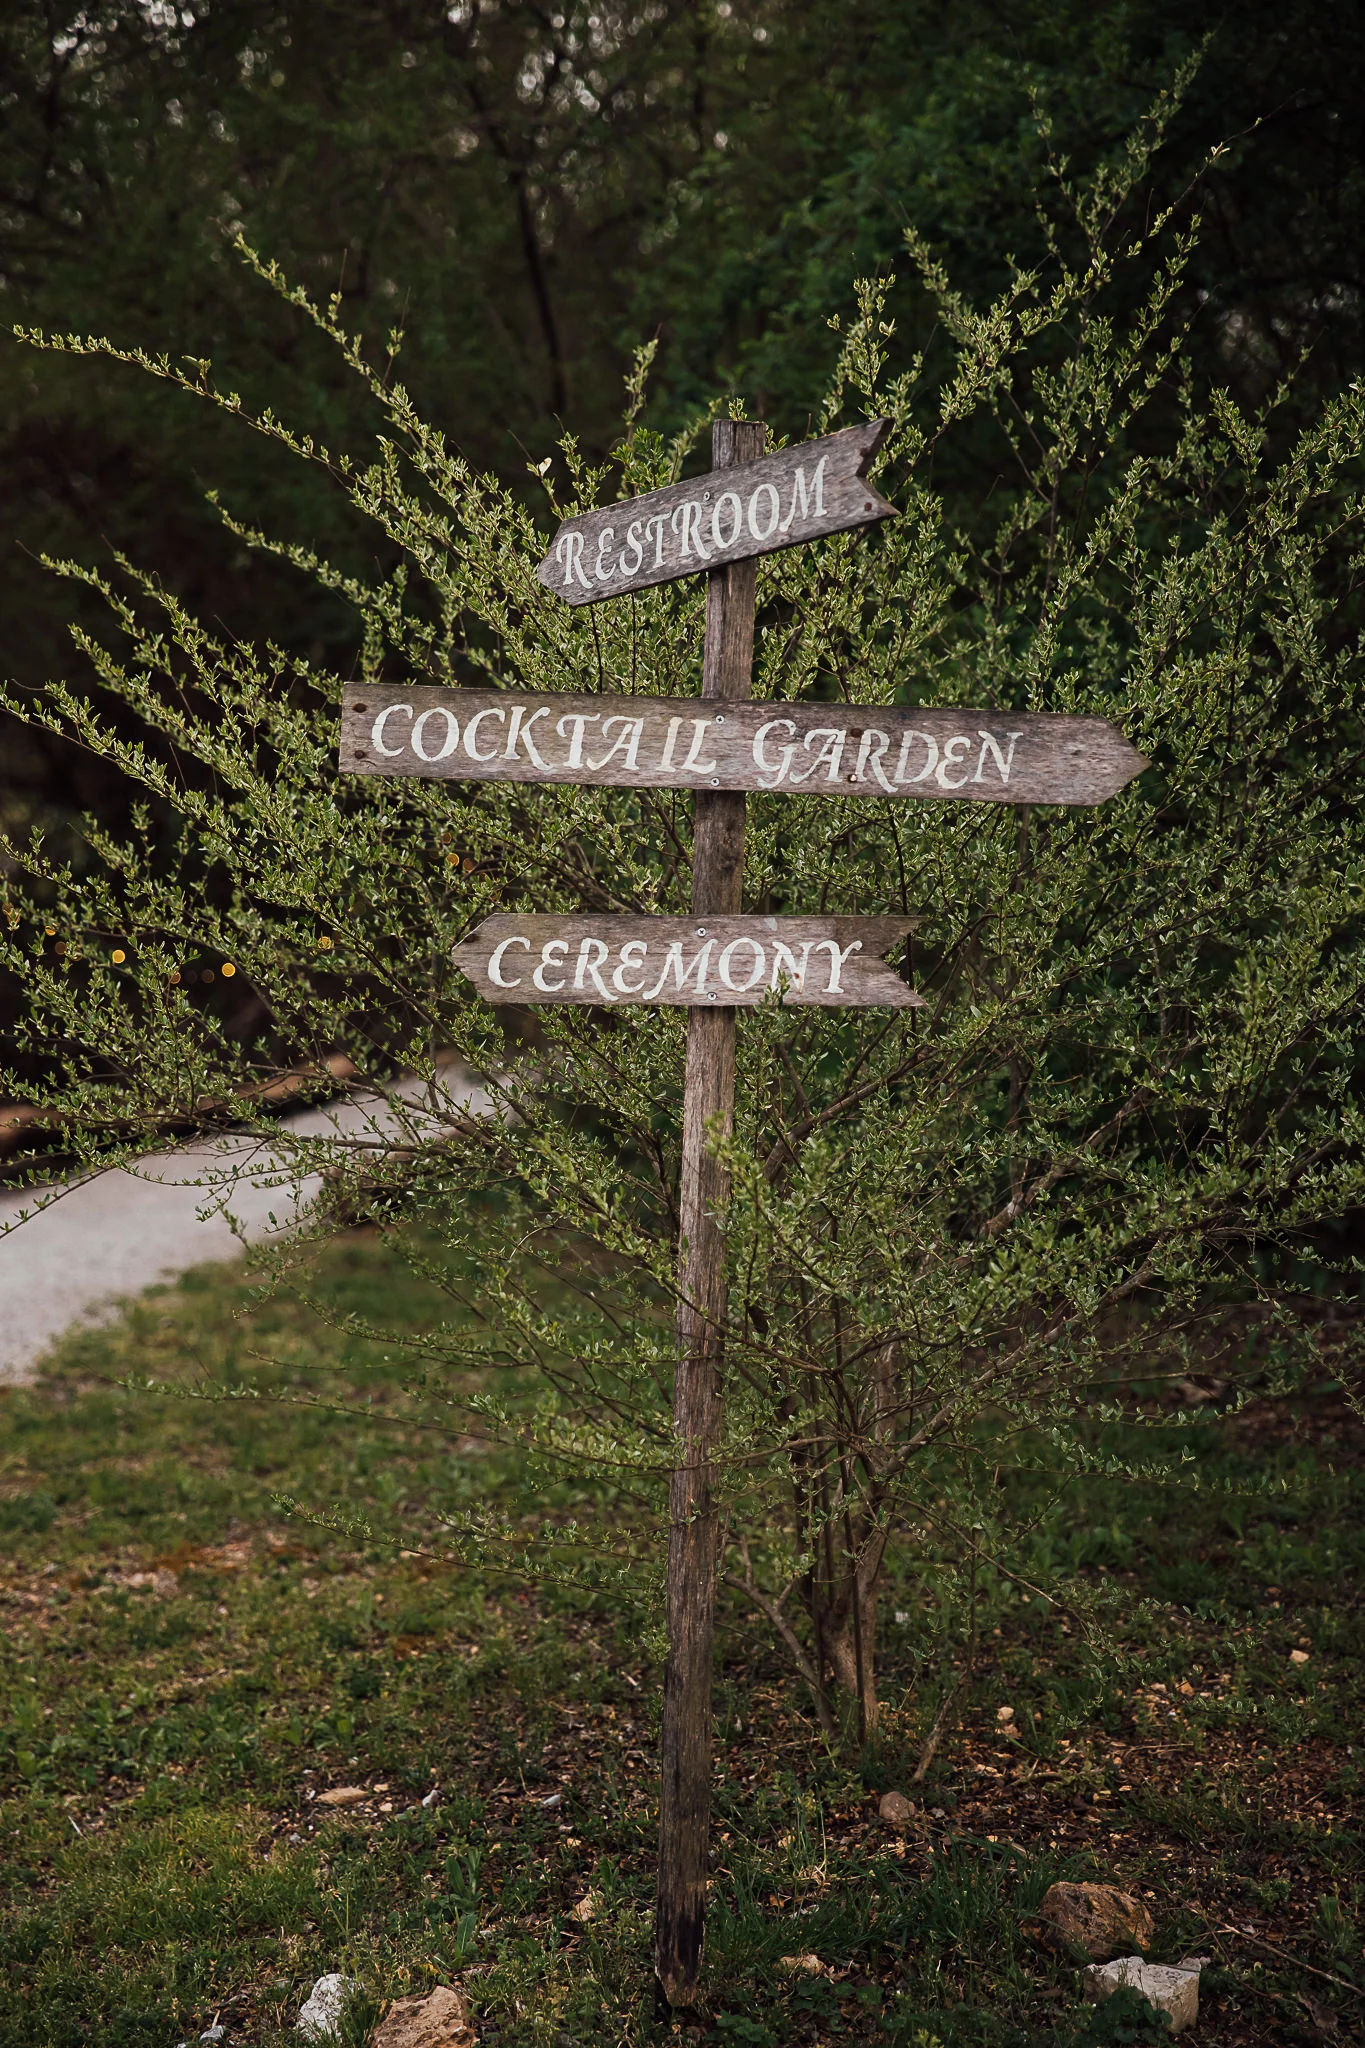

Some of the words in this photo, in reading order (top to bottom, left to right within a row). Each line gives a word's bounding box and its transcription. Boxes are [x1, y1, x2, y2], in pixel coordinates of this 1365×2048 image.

[556, 455, 829, 589] RESTROOM
[371, 704, 717, 774] COCKTAIL
[752, 719, 1024, 793] GARDEN
[487, 936, 863, 1000] CEREMONY
